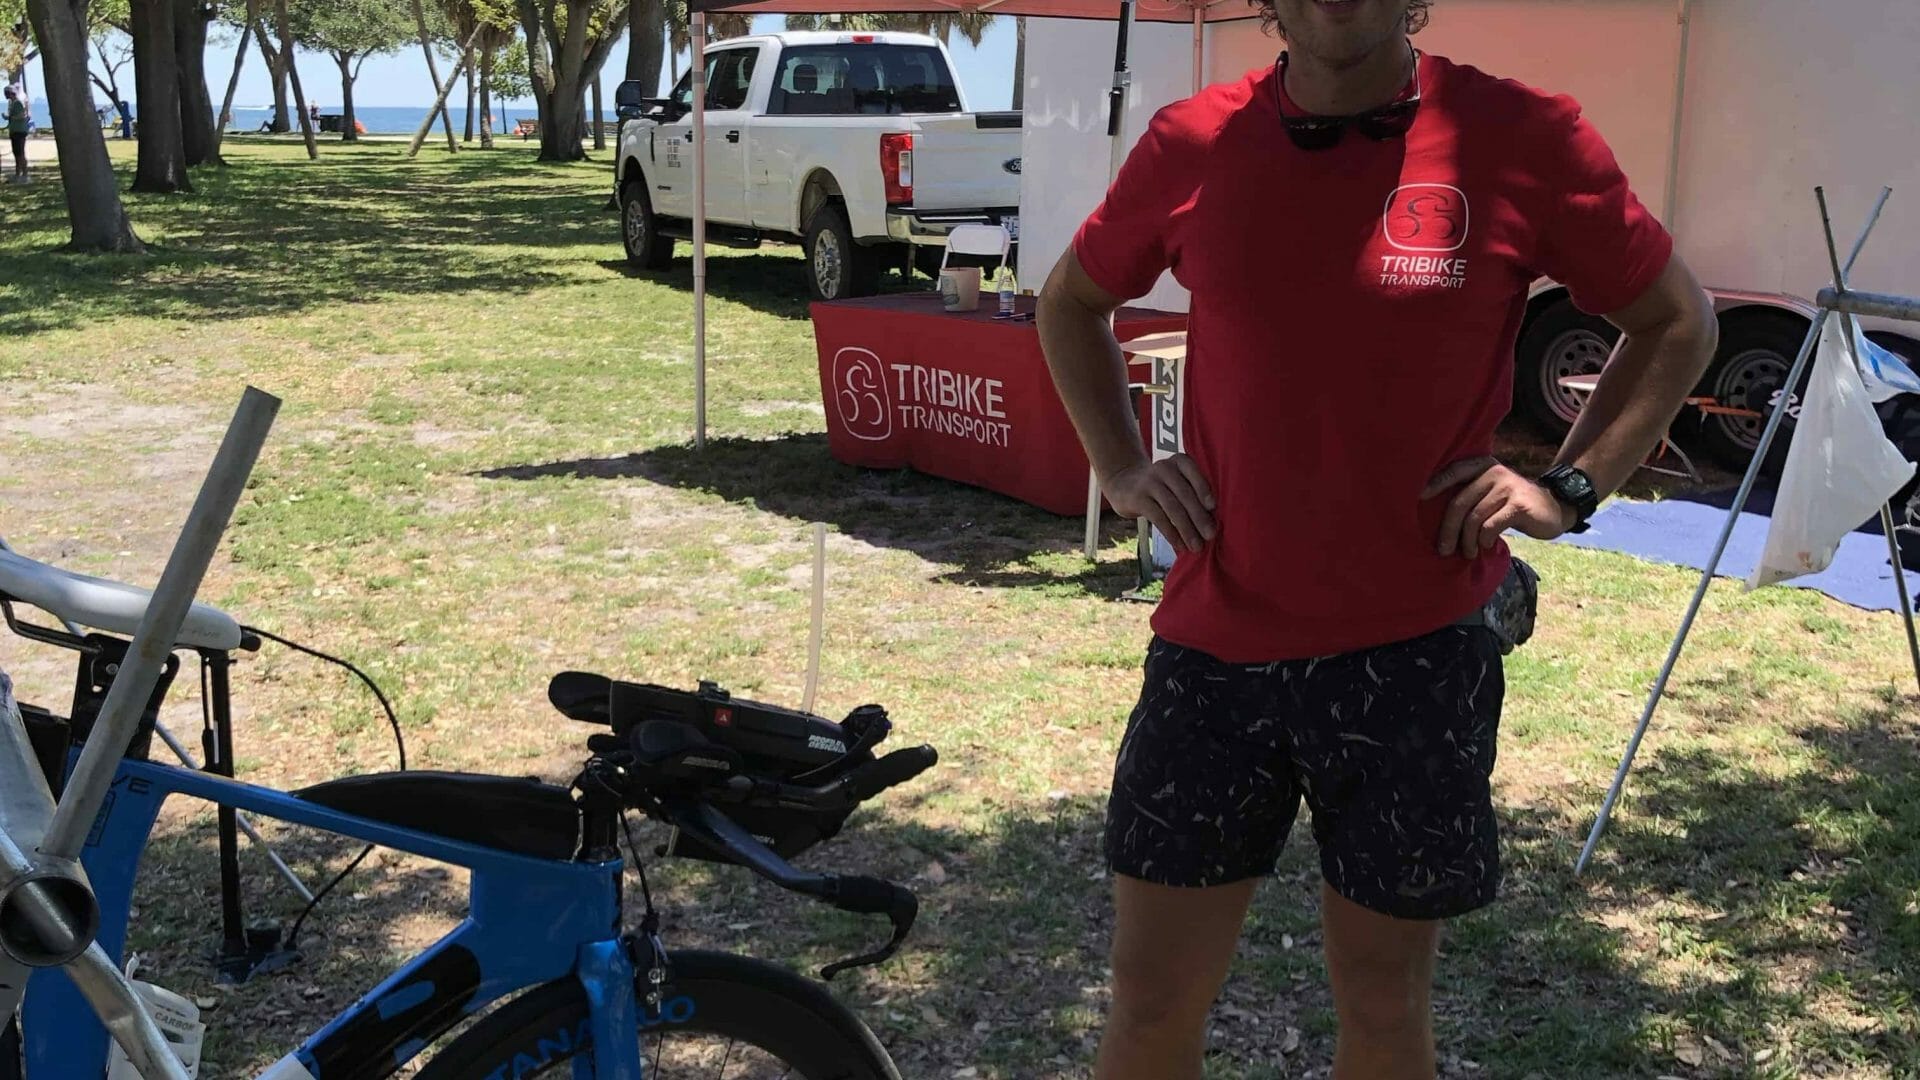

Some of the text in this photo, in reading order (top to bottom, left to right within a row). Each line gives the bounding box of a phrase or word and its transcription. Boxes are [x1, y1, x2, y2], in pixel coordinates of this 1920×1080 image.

[1381, 256, 1467, 275] TRIBIKE
[1380, 274, 1466, 289] TRANSPORT
[890, 363, 1006, 419] TRIBIKE
[898, 405, 1012, 448] TRANSPORT
